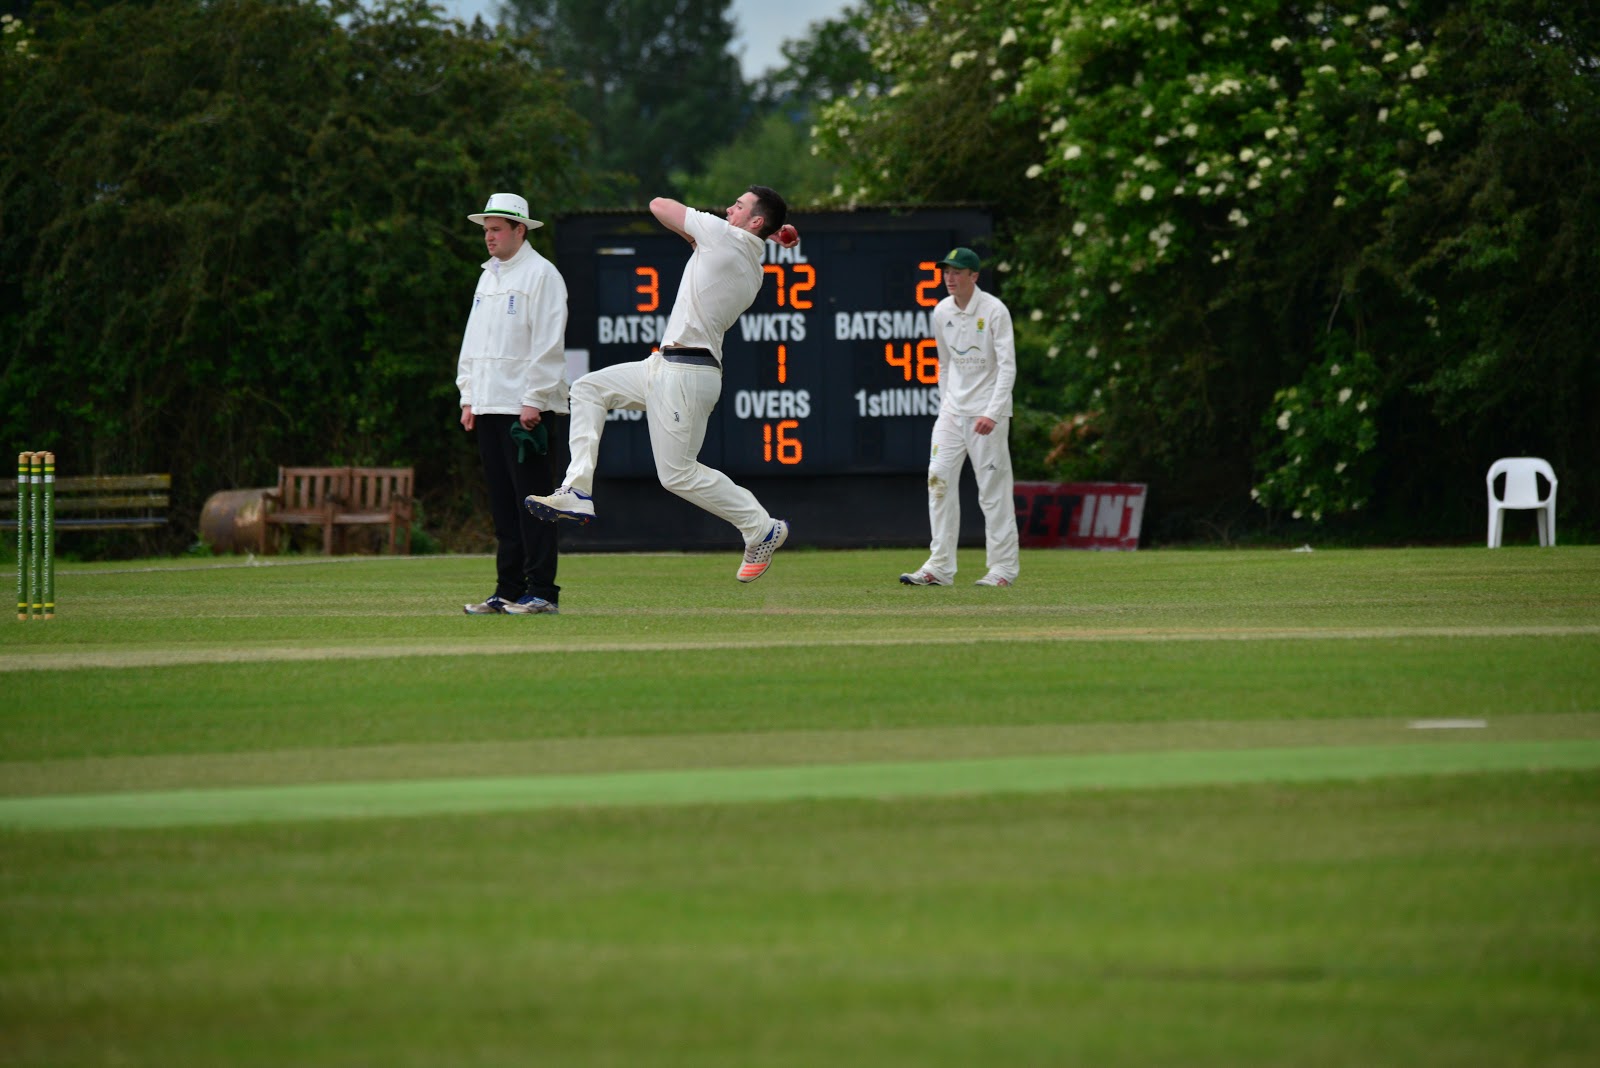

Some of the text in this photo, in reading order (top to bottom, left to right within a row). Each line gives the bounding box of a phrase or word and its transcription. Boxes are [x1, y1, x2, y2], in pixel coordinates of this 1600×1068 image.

[760, 236, 808, 264] TAL
[635, 266, 659, 312] 3
[763, 264, 816, 309] 72
[916, 261, 942, 307] 2
[740, 313, 806, 341] WKTS
[777, 344, 786, 383] 1
[885, 338, 939, 384] 46
[735, 390, 810, 418] OVERS
[763, 420, 802, 464] 16
